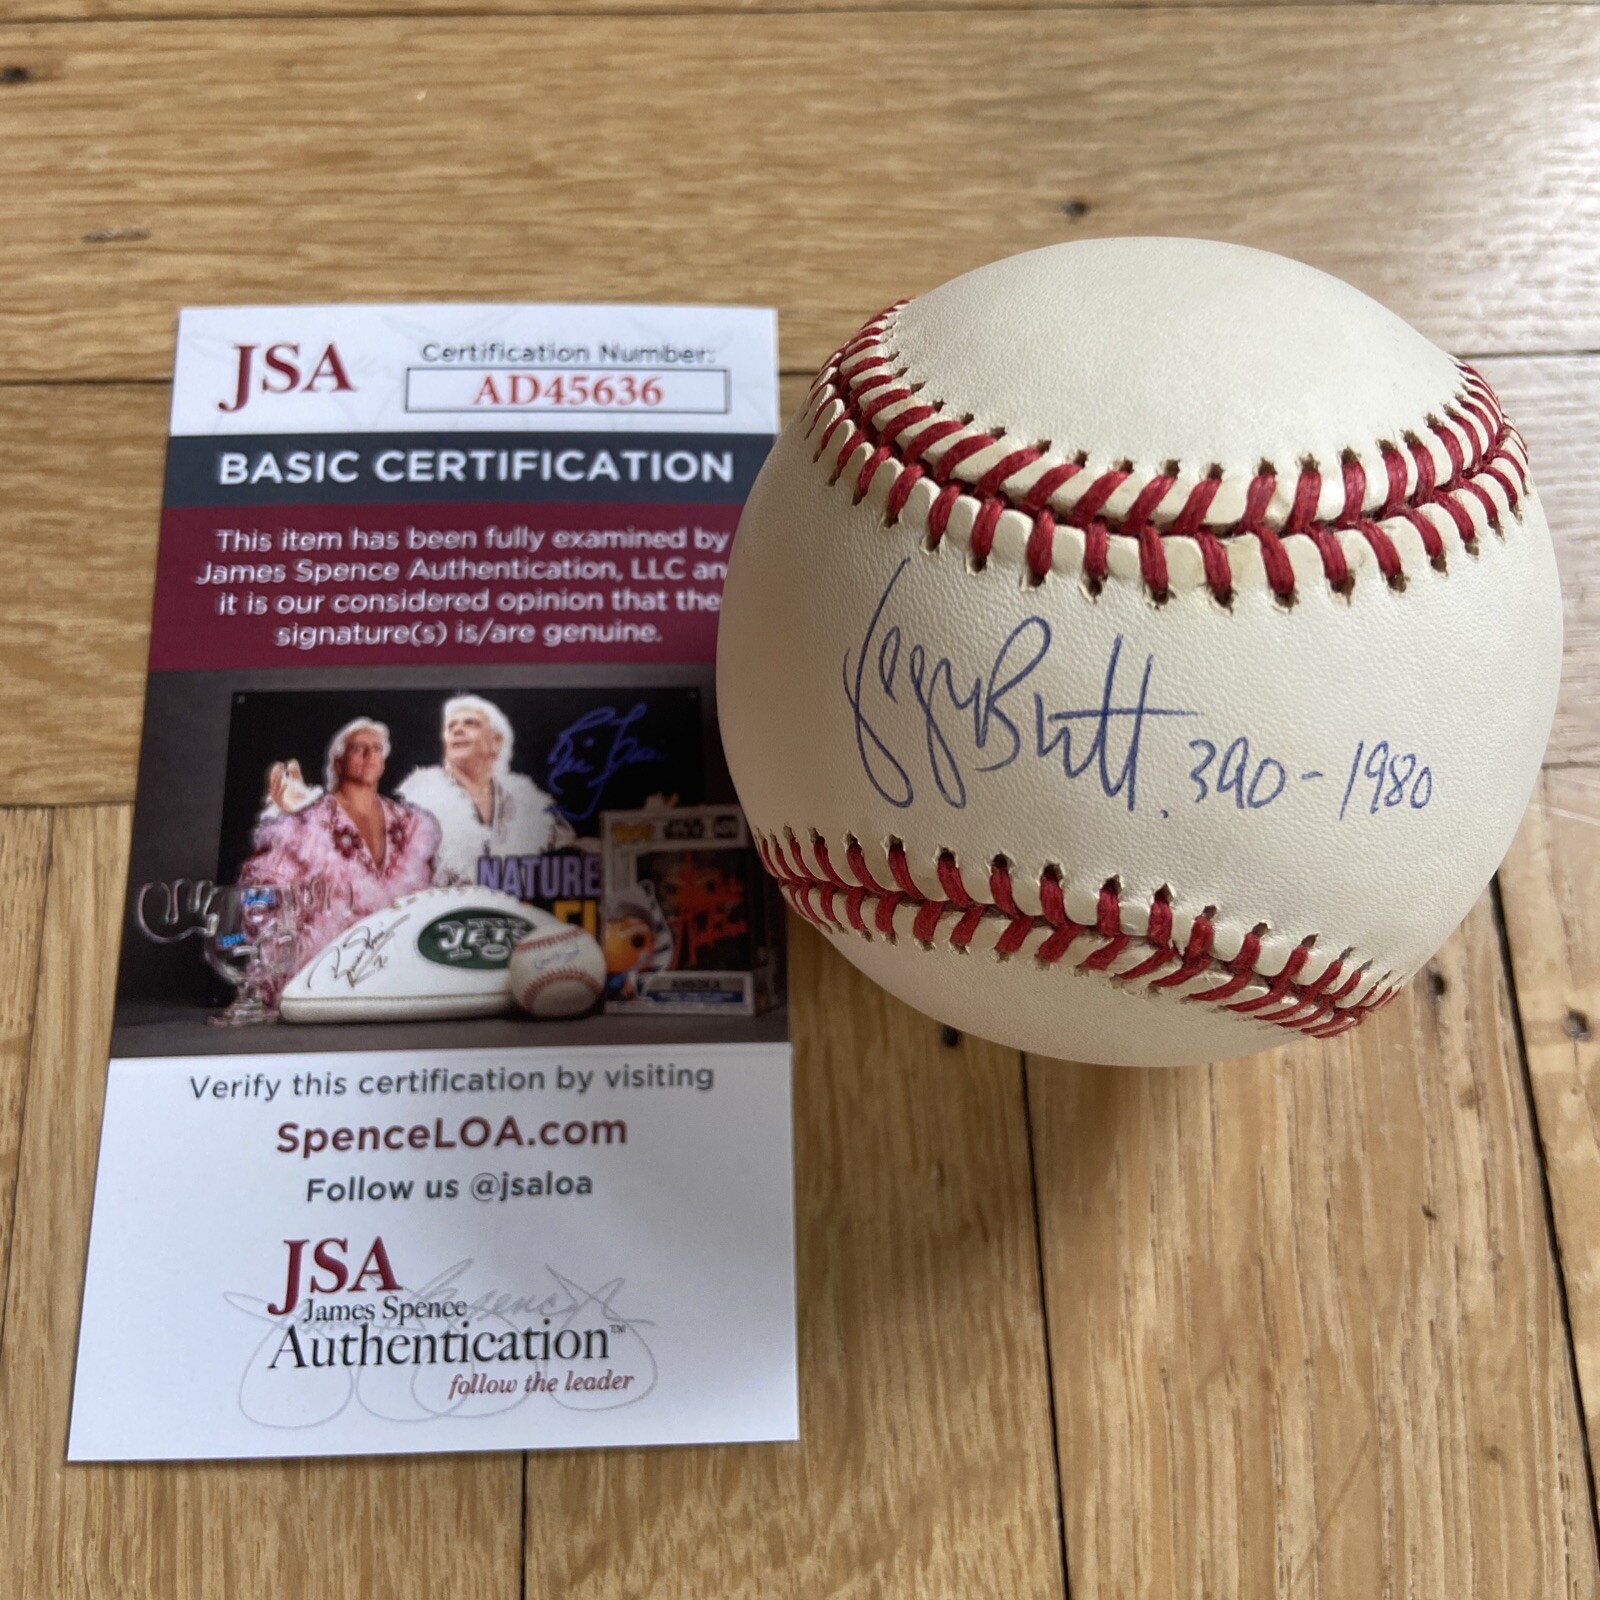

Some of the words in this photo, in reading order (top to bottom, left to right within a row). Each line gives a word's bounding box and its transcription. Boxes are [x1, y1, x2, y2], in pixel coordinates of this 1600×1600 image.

[421, 342, 590, 364] Certification
[599, 344, 716, 364] Number:
[218, 341, 357, 413] JSA
[472, 373, 664, 407] AD45636
[218, 451, 360, 485] BASIC
[373, 450, 735, 483] CERTIFICATION
[216, 528, 272, 551] This
[280, 527, 343, 550] item
[351, 526, 399, 550] has
[407, 525, 477, 549] been
[484, 524, 545, 552] fully
[551, 525, 687, 549] examined
[693, 525, 731, 553] by
[196, 561, 287, 585] James
[294, 558, 400, 586] Spence
[407, 555, 624, 581] Authentication,
[629, 556, 686, 580] LLC
[216, 591, 238, 616] it
[245, 591, 268, 615] is
[274, 595, 325, 615] our
[331, 587, 489, 614] considered
[495, 586, 605, 615] opinion
[610, 585, 670, 612] that
[675, 587, 723, 612] the
[275, 620, 447, 650] signature(s)
[453, 618, 535, 647] is/are
[542, 619, 663, 648] genuine.
[1339, 740, 1433, 821] 1980
[478, 856, 602, 899] NATURE
[190, 1074, 281, 1102] Verify
[292, 1072, 347, 1096] this
[358, 1068, 545, 1095] certification
[556, 1065, 594, 1093] by
[604, 1063, 715, 1091] visiting
[277, 1114, 628, 1159] SpenceLOA.com
[307, 1176, 415, 1202] Follow
[426, 1178, 459, 1199] us
[470, 1171, 594, 1201] @jsaloa
[266, 1236, 403, 1316] JSA
[304, 1299, 376, 1322] James
[382, 1296, 467, 1326] Spence
[447, 1371, 517, 1400] follow
[523, 1370, 558, 1393] the
[564, 1370, 635, 1391] leader
